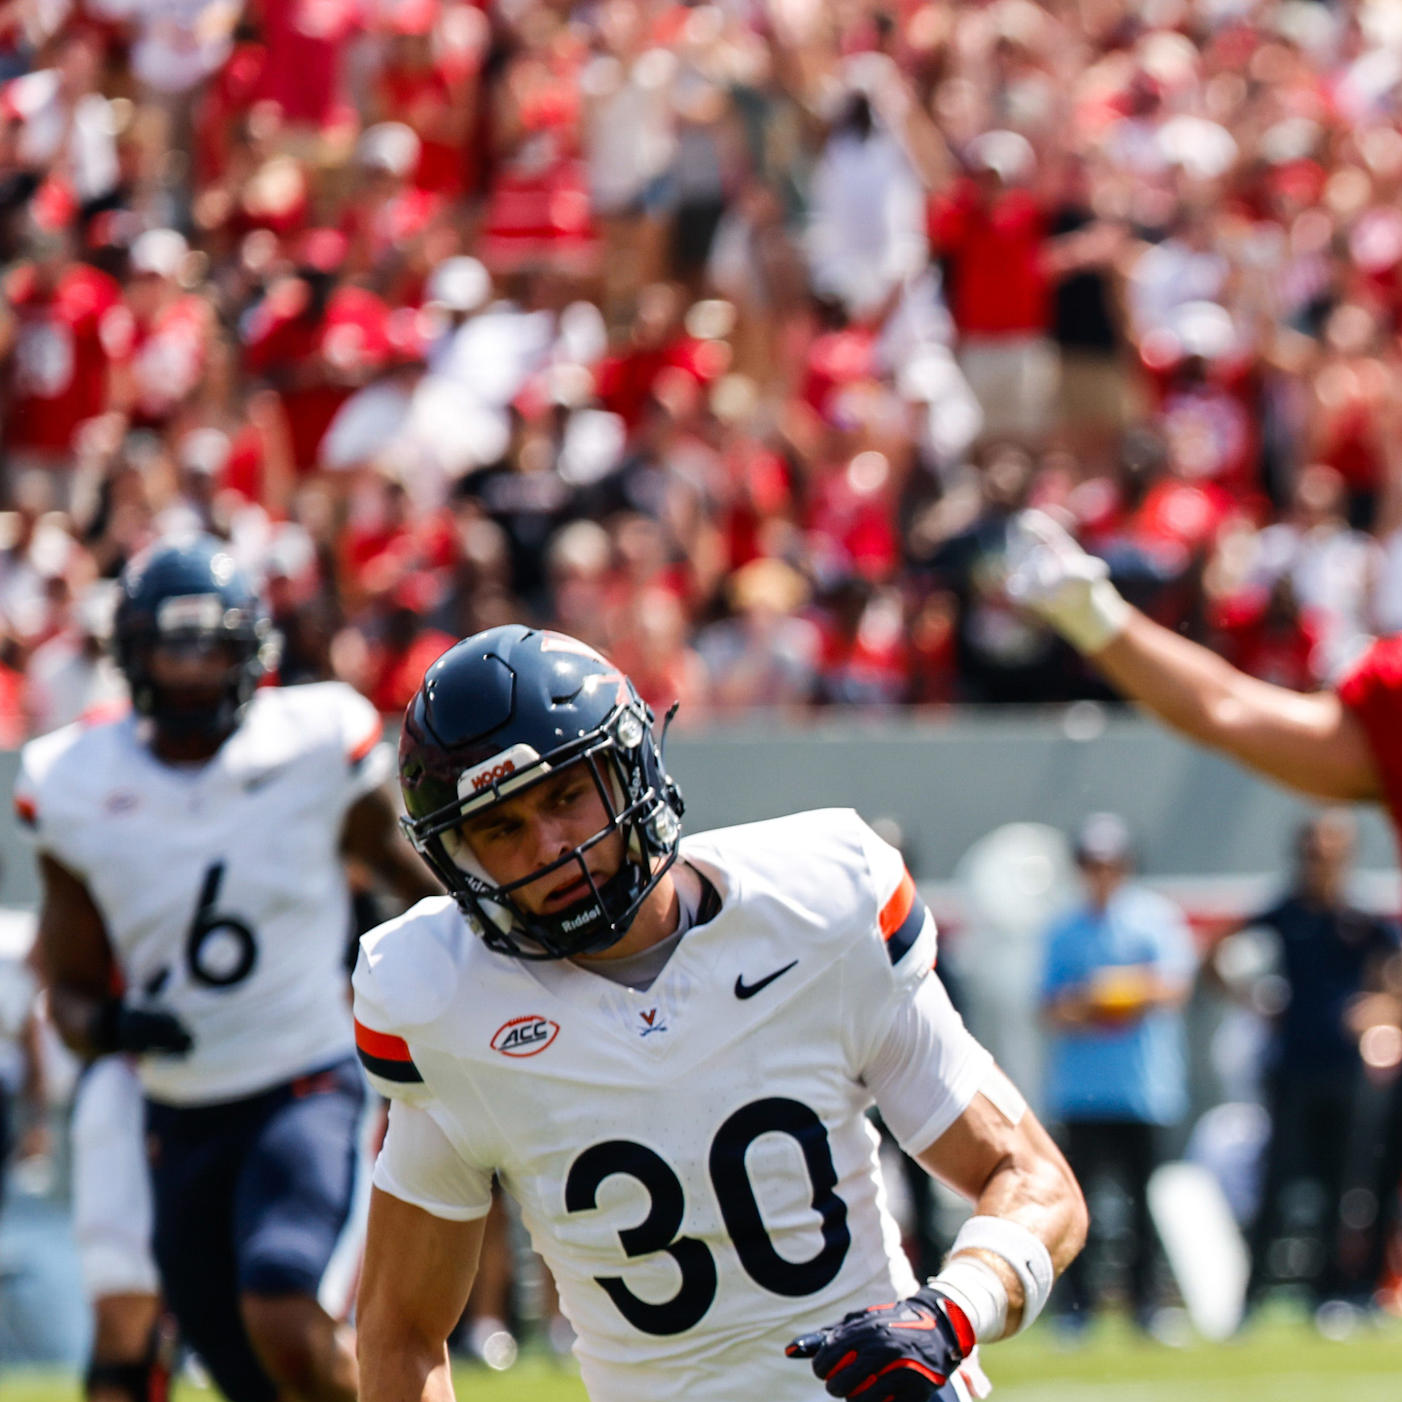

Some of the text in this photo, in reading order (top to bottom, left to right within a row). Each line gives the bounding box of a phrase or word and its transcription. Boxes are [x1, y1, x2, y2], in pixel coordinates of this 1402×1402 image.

[471, 760, 516, 791] HOOS
[185, 859, 257, 987] 6
[561, 904, 602, 933] Riddel
[500, 1020, 547, 1050] ACC
[565, 1097, 851, 1337] 30
